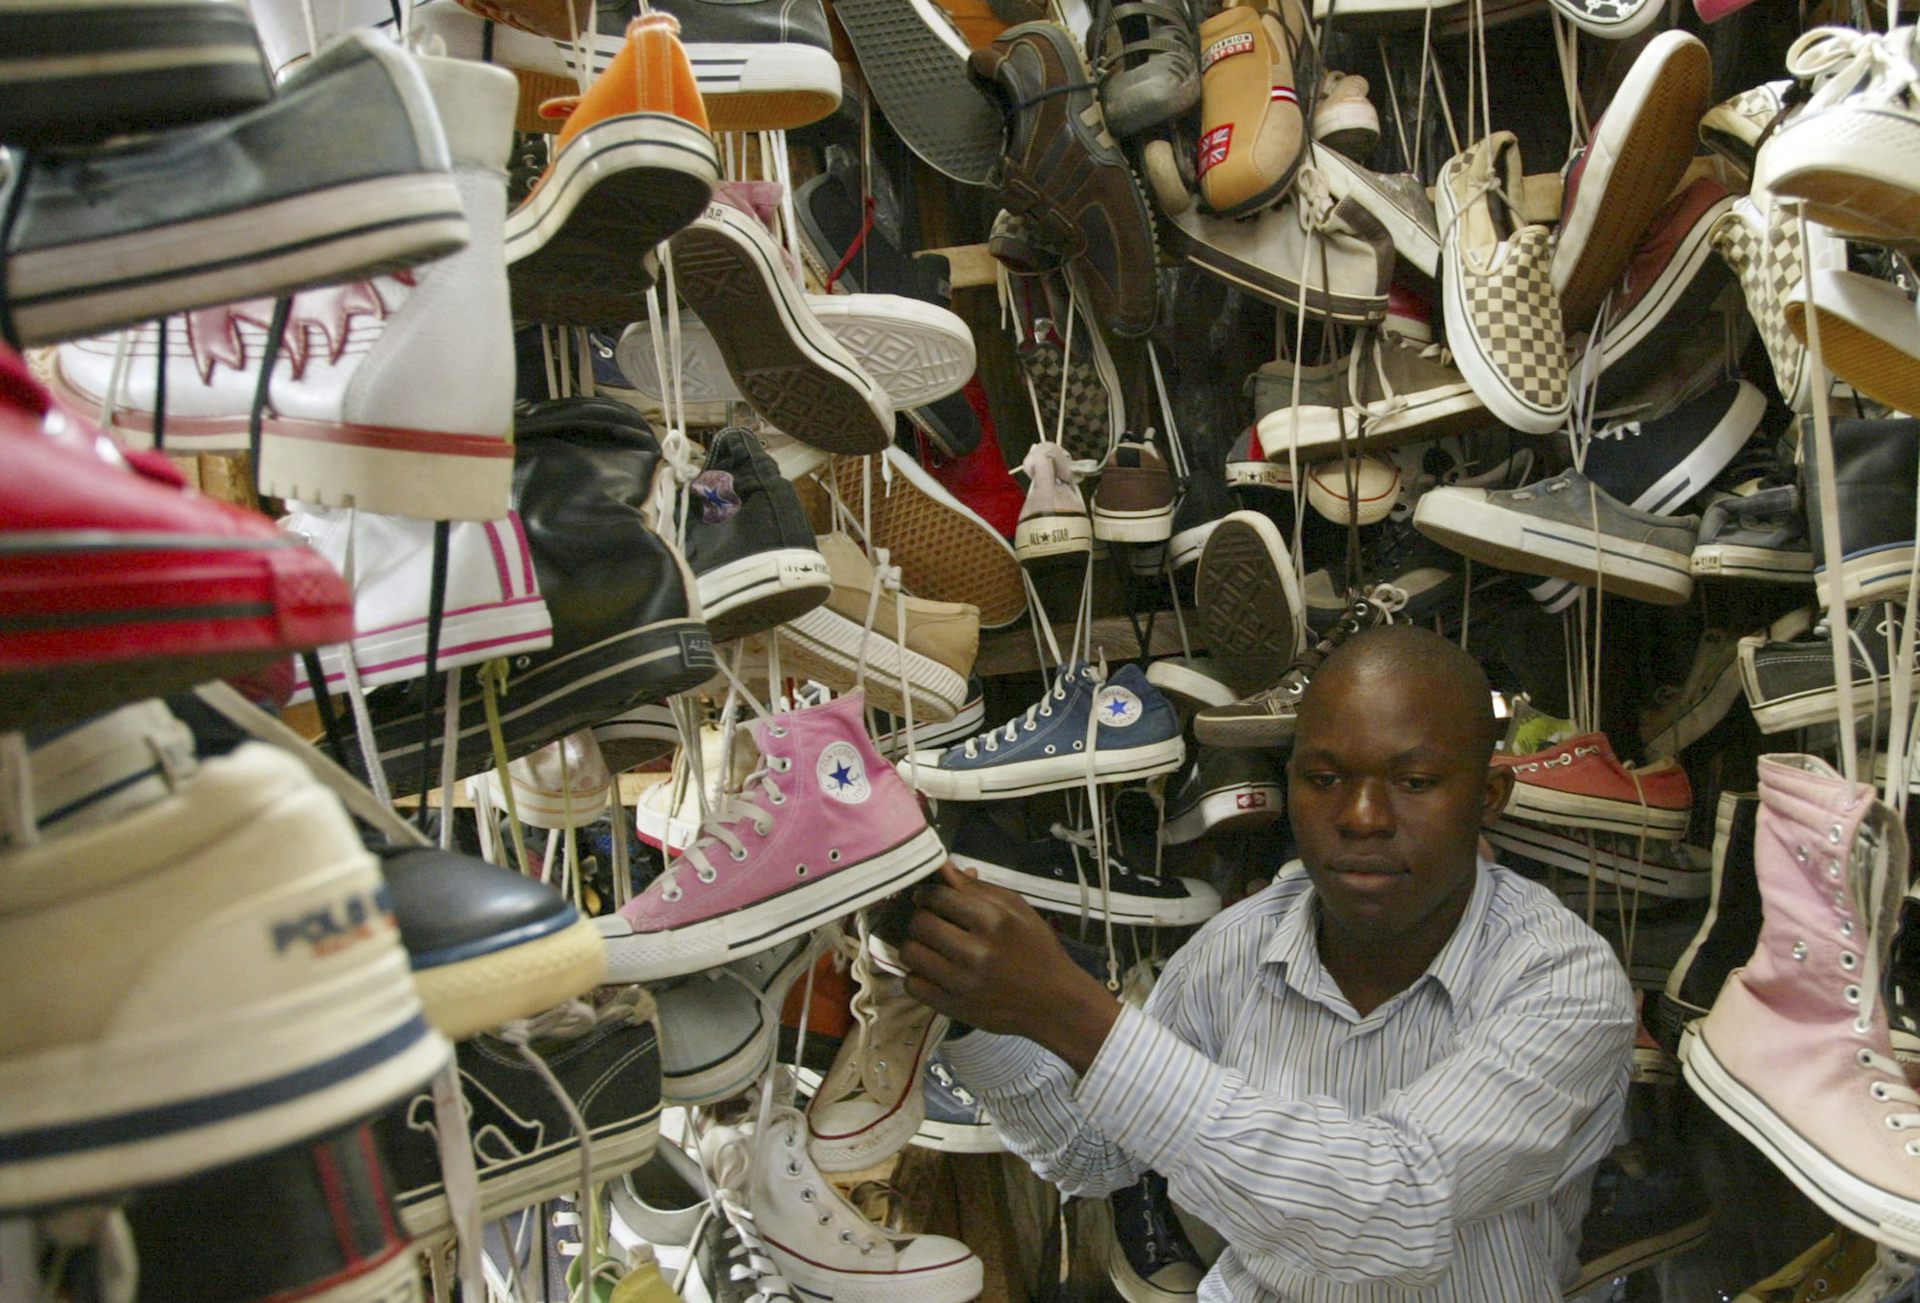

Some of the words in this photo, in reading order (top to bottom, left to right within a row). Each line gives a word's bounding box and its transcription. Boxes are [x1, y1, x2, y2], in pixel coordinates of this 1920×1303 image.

[1213, 42, 1251, 61] SPORT
[1029, 531, 1041, 545] ALL
[1051, 527, 1070, 543] STAR
